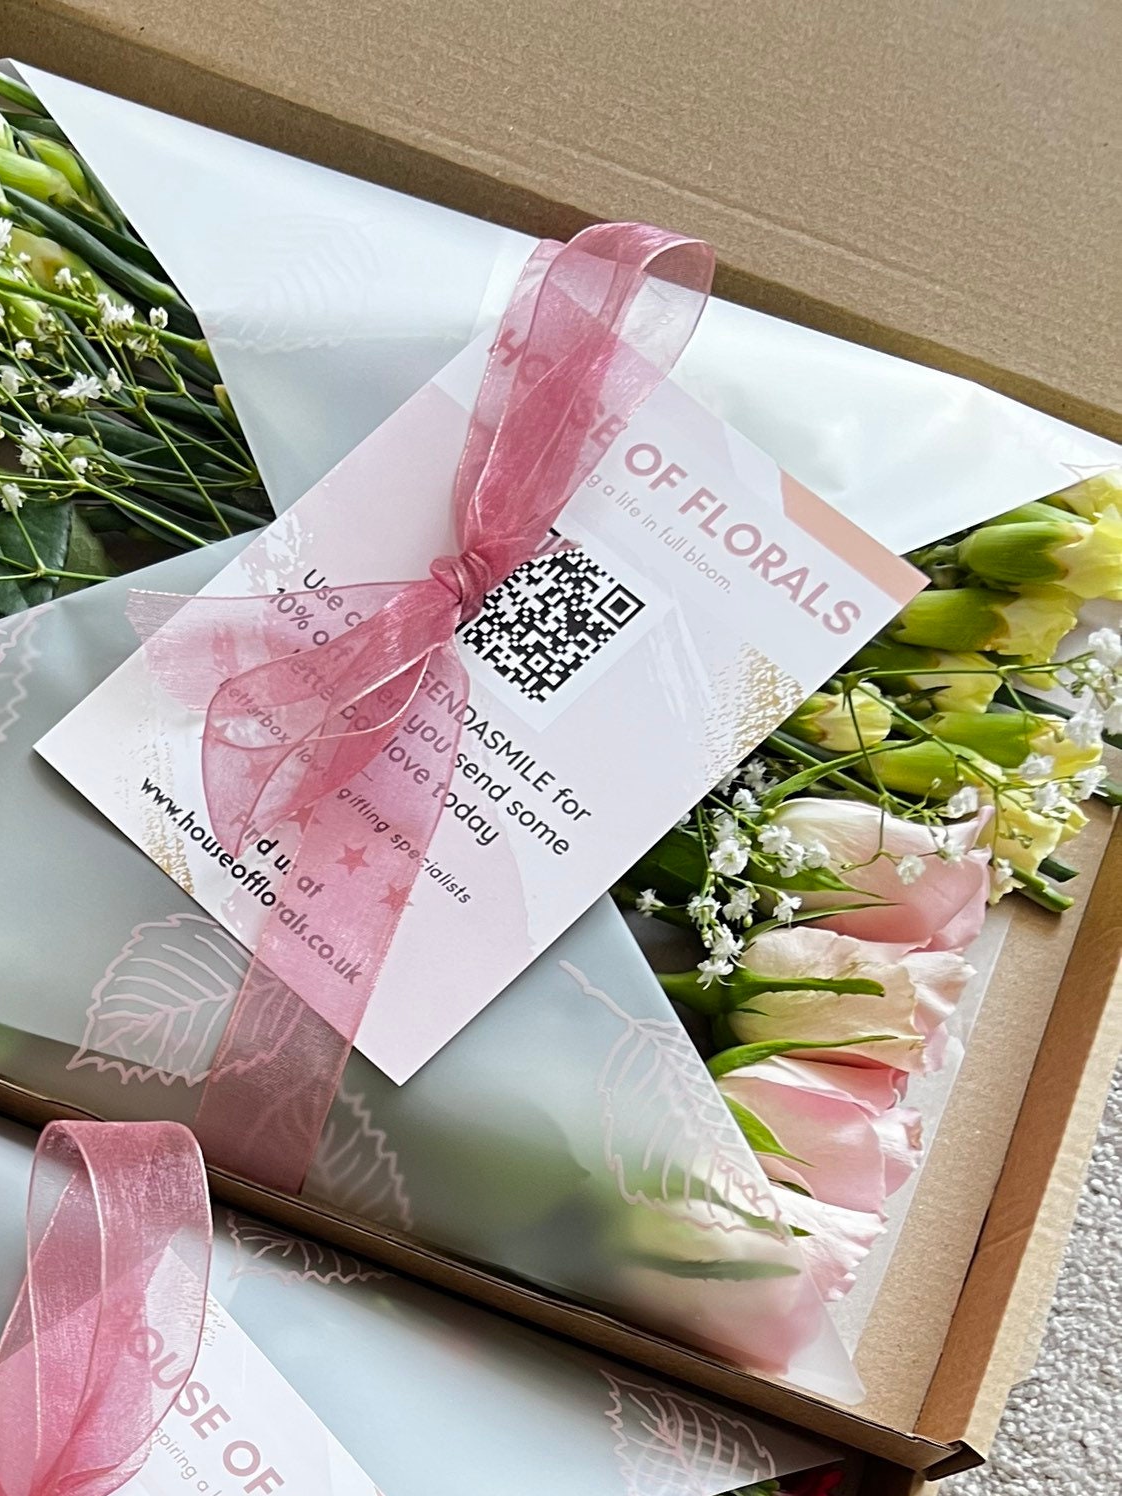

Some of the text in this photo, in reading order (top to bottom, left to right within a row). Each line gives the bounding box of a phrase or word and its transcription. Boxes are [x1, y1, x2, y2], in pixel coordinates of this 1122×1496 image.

[487, 328, 628, 448] HOSE
[625, 443, 688, 486] OF
[677, 486, 858, 634] FLORALS
[602, 484, 731, 594] a life in full bloom.
[267, 587, 314, 631] 10%
[403, 713, 452, 756] you
[450, 752, 511, 803] send
[505, 799, 570, 856] some
[304, 568, 590, 820] Use SENDASMILE for
[336, 786, 390, 832] gifting
[389, 832, 471, 905] specialists
[381, 736, 431, 786] love
[430, 780, 499, 844] today
[295, 876, 325, 898] at
[110, 1306, 232, 1440] OUSE
[224, 1440, 284, 1494] OF
[148, 1418, 198, 1480] spiring
[195, 1478, 210, 1493] a
